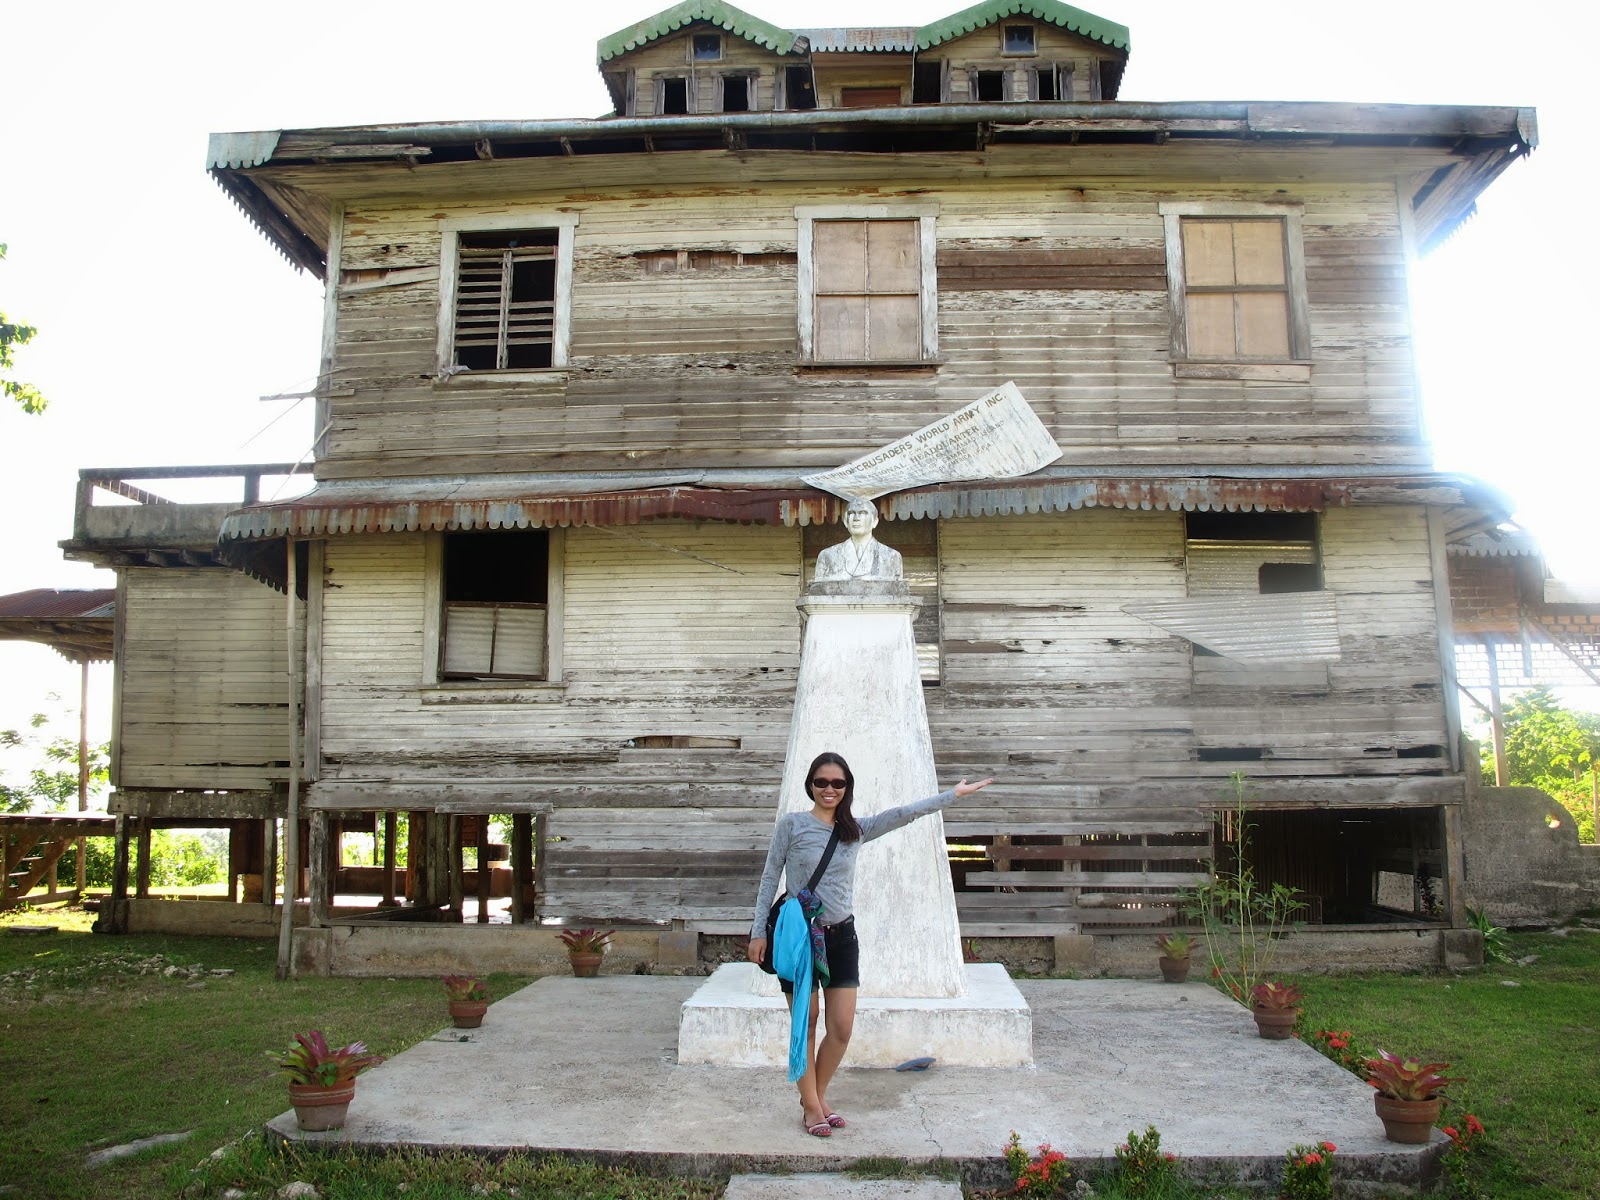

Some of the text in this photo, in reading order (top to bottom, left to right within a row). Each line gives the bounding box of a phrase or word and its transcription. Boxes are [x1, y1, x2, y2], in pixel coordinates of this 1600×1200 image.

[856, 441, 913, 472] CRUSADERS
[915, 422, 950, 444] WORLD
[952, 405, 981, 427] ARMY
[985, 393, 1007, 408] INC.
[909, 425, 980, 464] HEADQUARTER
